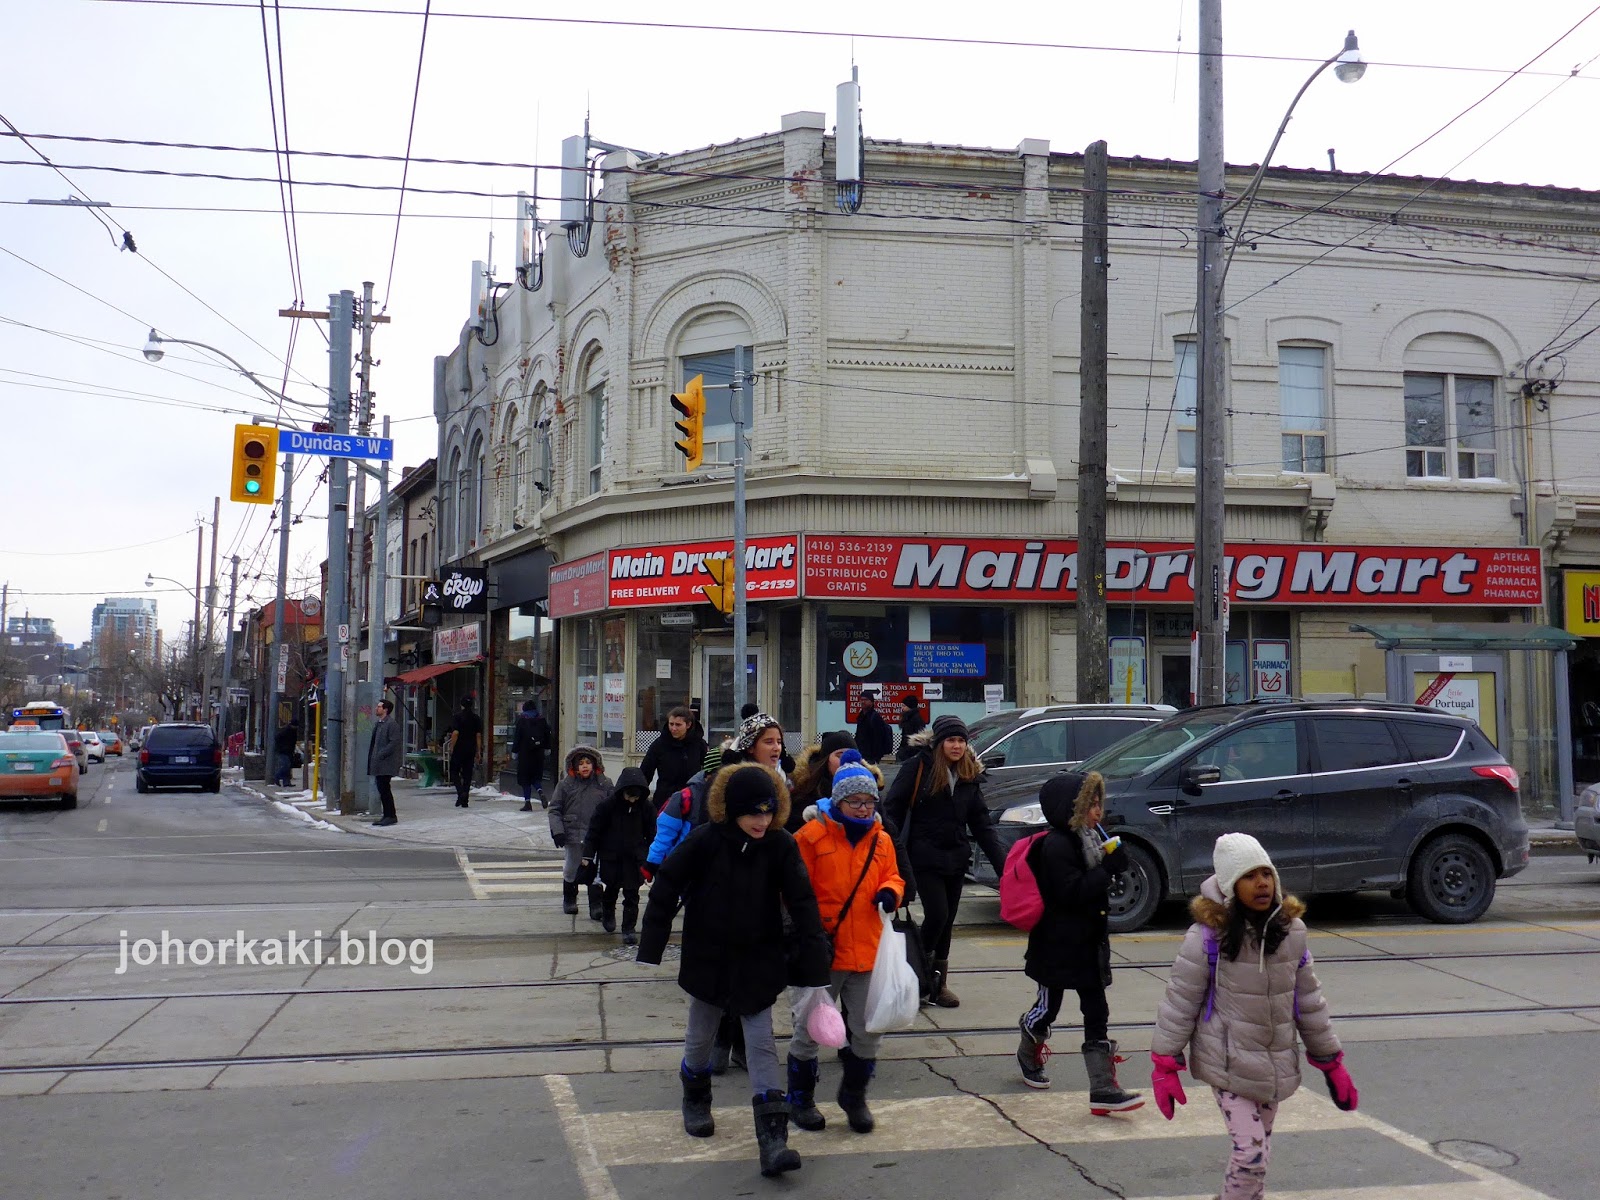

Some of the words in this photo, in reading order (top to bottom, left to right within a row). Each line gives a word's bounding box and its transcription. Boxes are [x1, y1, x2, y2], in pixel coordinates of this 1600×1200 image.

[291, 432, 352, 453] Dundas
[356, 438, 365, 448] St
[367, 439, 381, 455] W
[807, 541, 835, 552] (416)
[839, 542, 893, 553] 536-2139
[807, 554, 832, 564] FREE
[837, 555, 888, 566] DELIVERY
[1493, 552, 1530, 562] APTEKA
[611, 551, 665, 579] Main
[671, 551, 728, 575] Dru
[892, 542, 1078, 589] Main
[1290, 551, 1477, 593] Mart
[1486, 564, 1537, 575] APOTHEKE
[807, 567, 888, 579] DISTRIBUICAO
[443, 577, 484, 596] GROW
[827, 581, 867, 592] GRATIS
[1486, 576, 1537, 587] FARMACIA
[611, 588, 634, 599] FREE
[636, 585, 680, 598] DELIVERY
[1483, 588, 1539, 599] PHARMACY
[453, 595, 472, 609] OP
[1253, 660, 1289, 670] PHARMACY
[1435, 699, 1474, 710] Portugal
